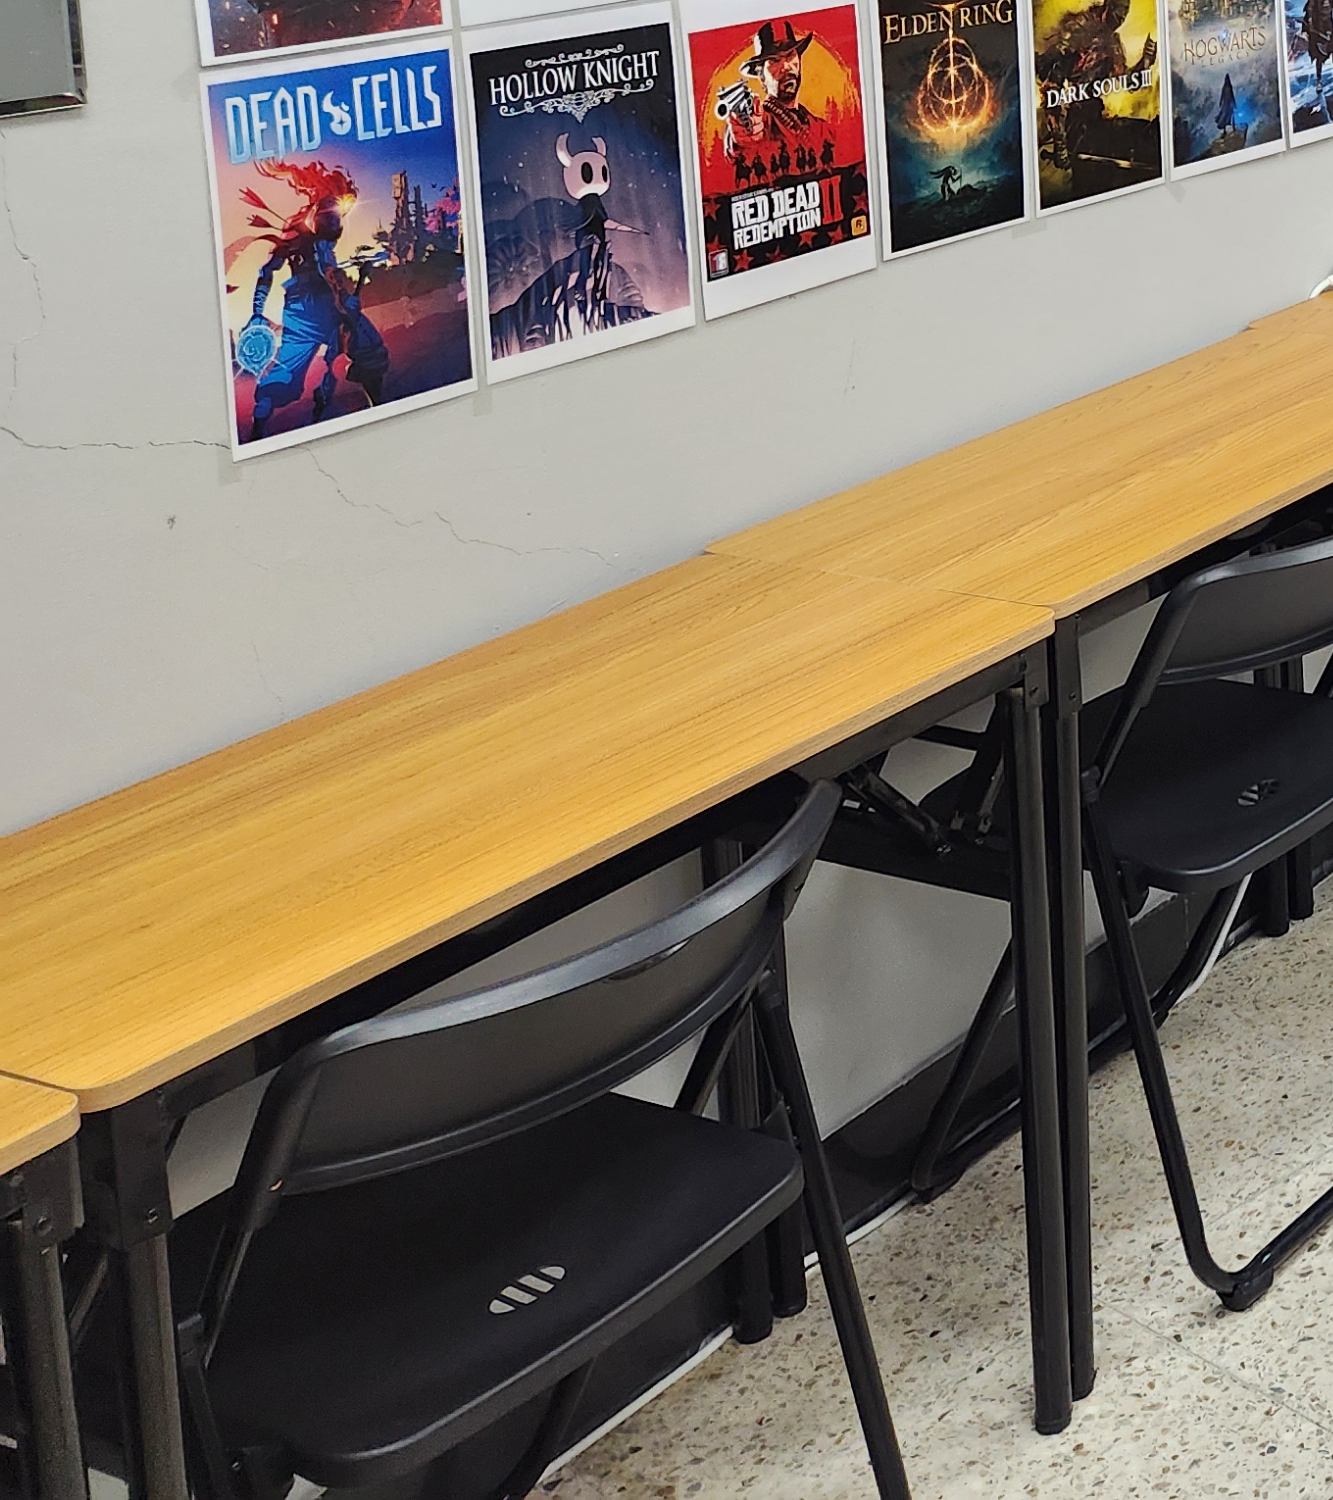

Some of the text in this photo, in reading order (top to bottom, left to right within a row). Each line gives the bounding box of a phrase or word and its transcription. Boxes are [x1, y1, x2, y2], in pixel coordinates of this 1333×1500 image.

[882, 9, 954, 44] ELDEN
[1180, 26, 1267, 66] HOGWARTS
[488, 50, 660, 105] HOLLOW KNIGHT
[1200, 51, 1250, 68] LEGACY
[1046, 69, 1153, 108] DARK SOULS III
[225, 65, 442, 164] DEAD CELLS
[731, 174, 845, 229] RED DEAD II
[733, 208, 822, 250] REDEMPTION
